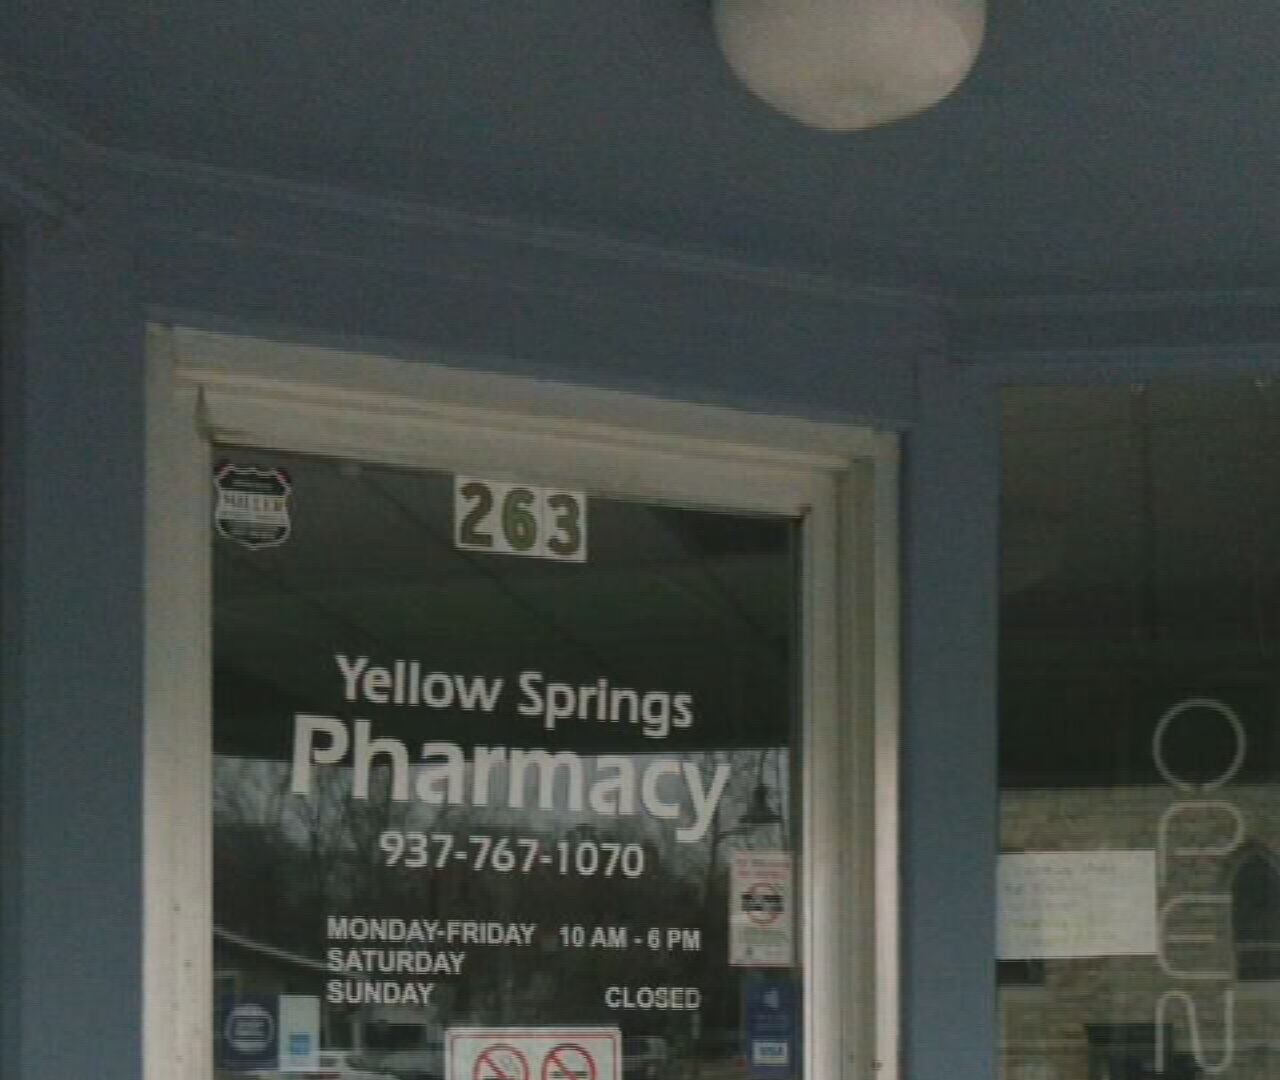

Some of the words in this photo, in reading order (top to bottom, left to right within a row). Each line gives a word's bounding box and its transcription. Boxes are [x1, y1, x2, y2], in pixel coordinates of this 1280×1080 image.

[459, 480, 583, 557] 263
[335, 655, 502, 712] Yellow
[518, 670, 694, 738] Springs
[290, 713, 732, 842] Pharmacy
[379, 830, 645, 879] 937-767-1070
[326, 916, 535, 947] MONDAY-FRIDAY
[559, 926, 581, 949] 10
[586, 927, 627, 951] AM
[648, 929, 661, 952] 6
[666, 929, 701, 952] PM
[326, 947, 465, 975] SATURDAY
[326, 979, 434, 1006] SUNDAY
[604, 985, 702, 1011] CLOSED
